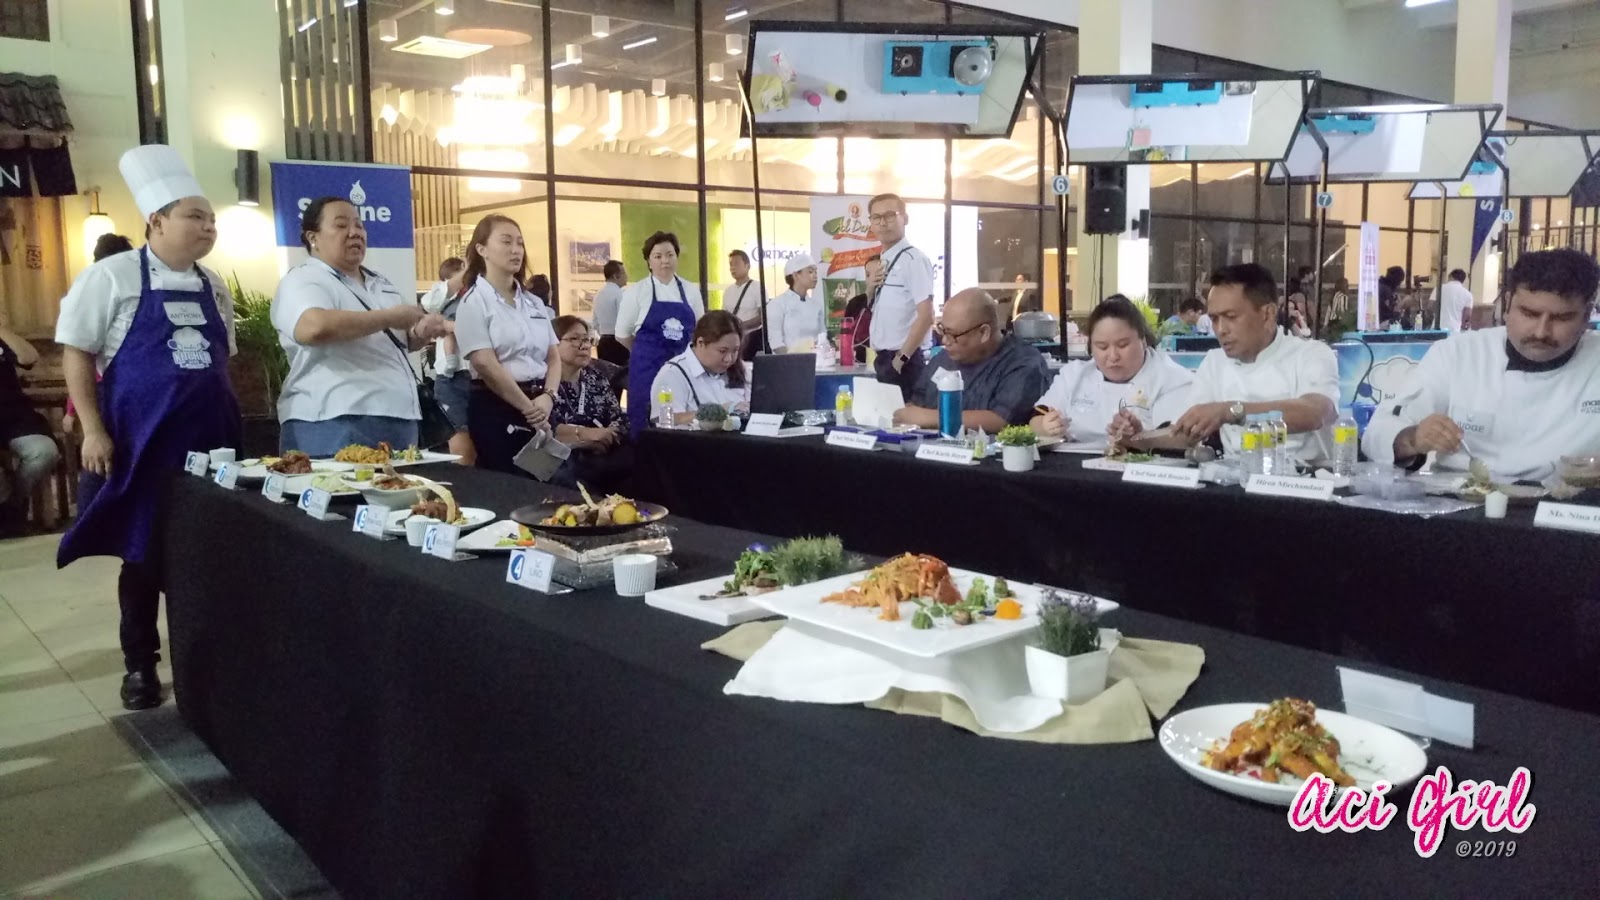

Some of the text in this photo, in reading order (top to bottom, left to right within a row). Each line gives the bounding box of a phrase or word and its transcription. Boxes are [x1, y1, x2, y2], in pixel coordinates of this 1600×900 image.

[1056, 177, 1065, 192] 6
[1321, 194, 1329, 206] 7
[1503, 210, 1510, 222] 8
[1456, 420, 1485, 433] JUDGE
[922, 448, 936, 456] Chef
[304, 489, 313, 507] 3
[514, 556, 524, 580] 4
